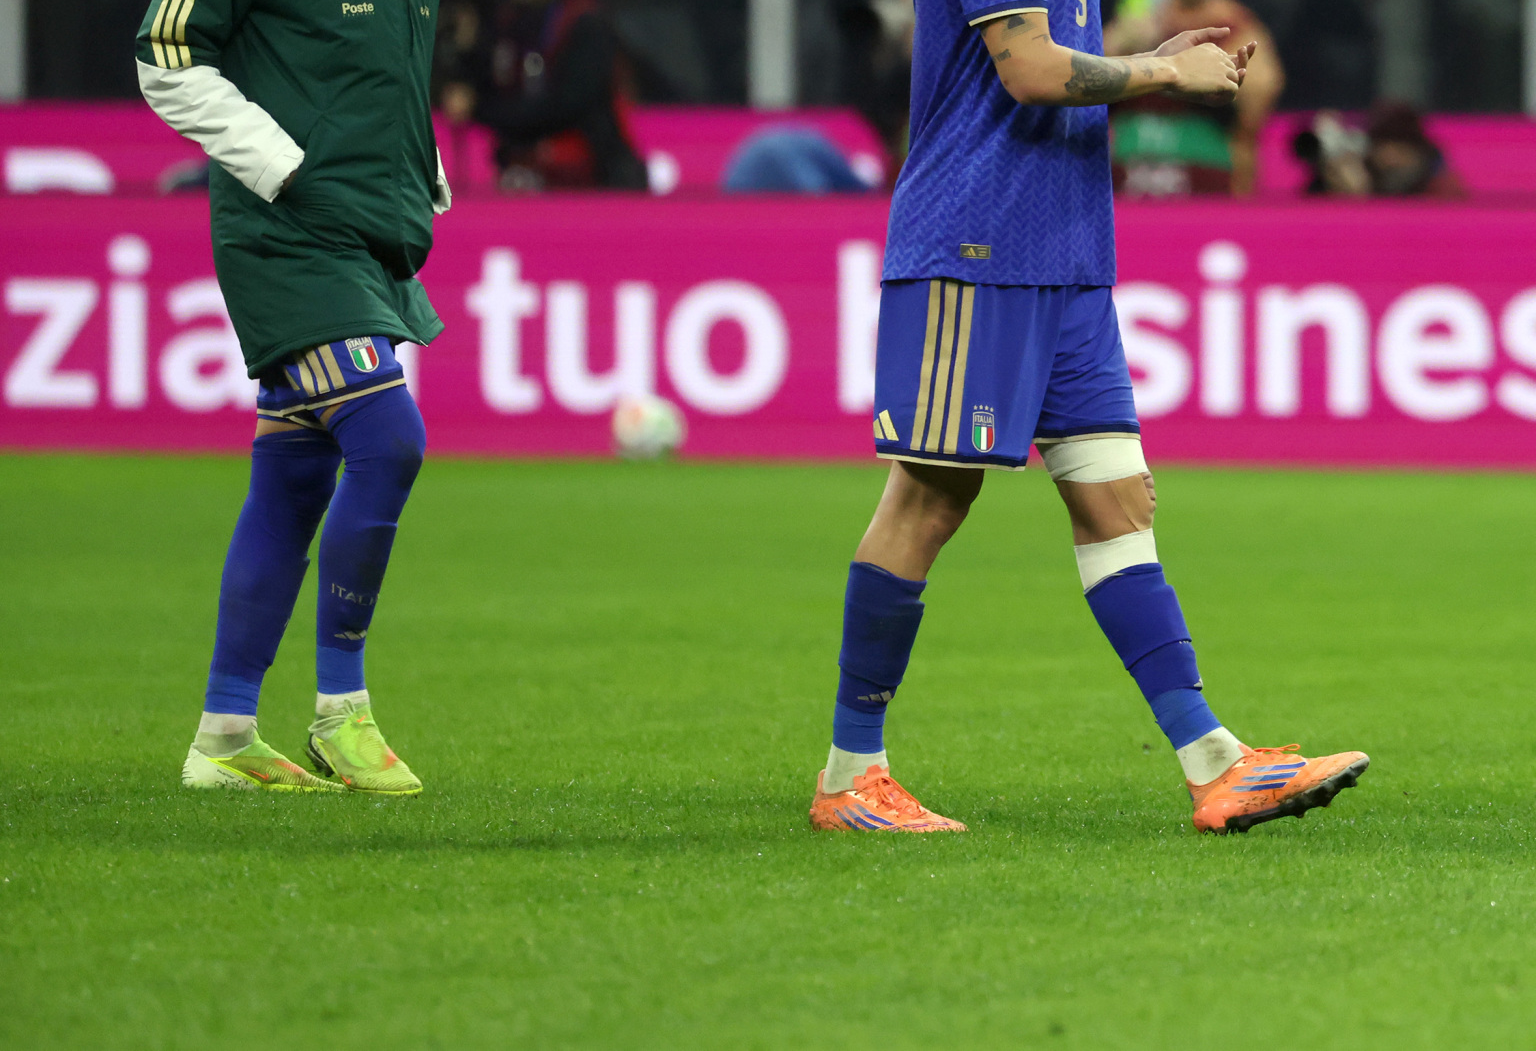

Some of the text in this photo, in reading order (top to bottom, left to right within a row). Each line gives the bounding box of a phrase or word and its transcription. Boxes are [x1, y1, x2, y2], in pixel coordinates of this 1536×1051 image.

[342, 2, 374, 15] Poste
[467, 249, 788, 415] tuo
[974, 414, 993, 424] ITALIA
[331, 583, 380, 606] ITALI
